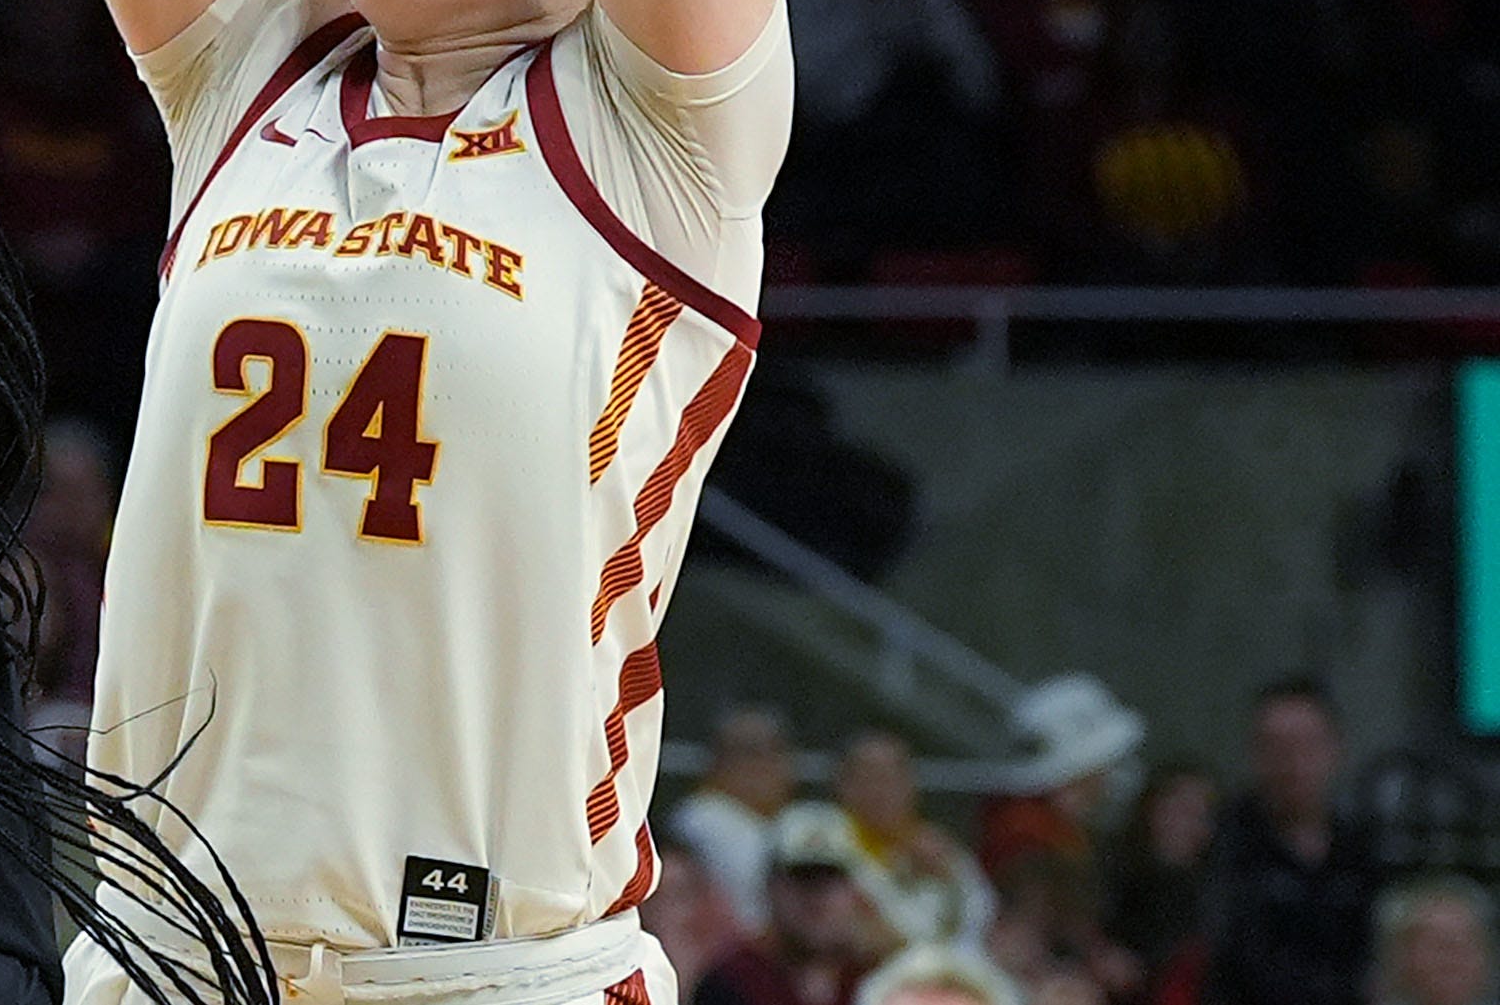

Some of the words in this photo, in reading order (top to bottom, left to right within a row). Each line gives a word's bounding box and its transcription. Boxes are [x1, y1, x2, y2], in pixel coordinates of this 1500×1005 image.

[194, 207, 335, 271] IOWA
[333, 208, 524, 302] STATE
[204, 316, 441, 545] 24
[421, 869, 469, 894] 44
